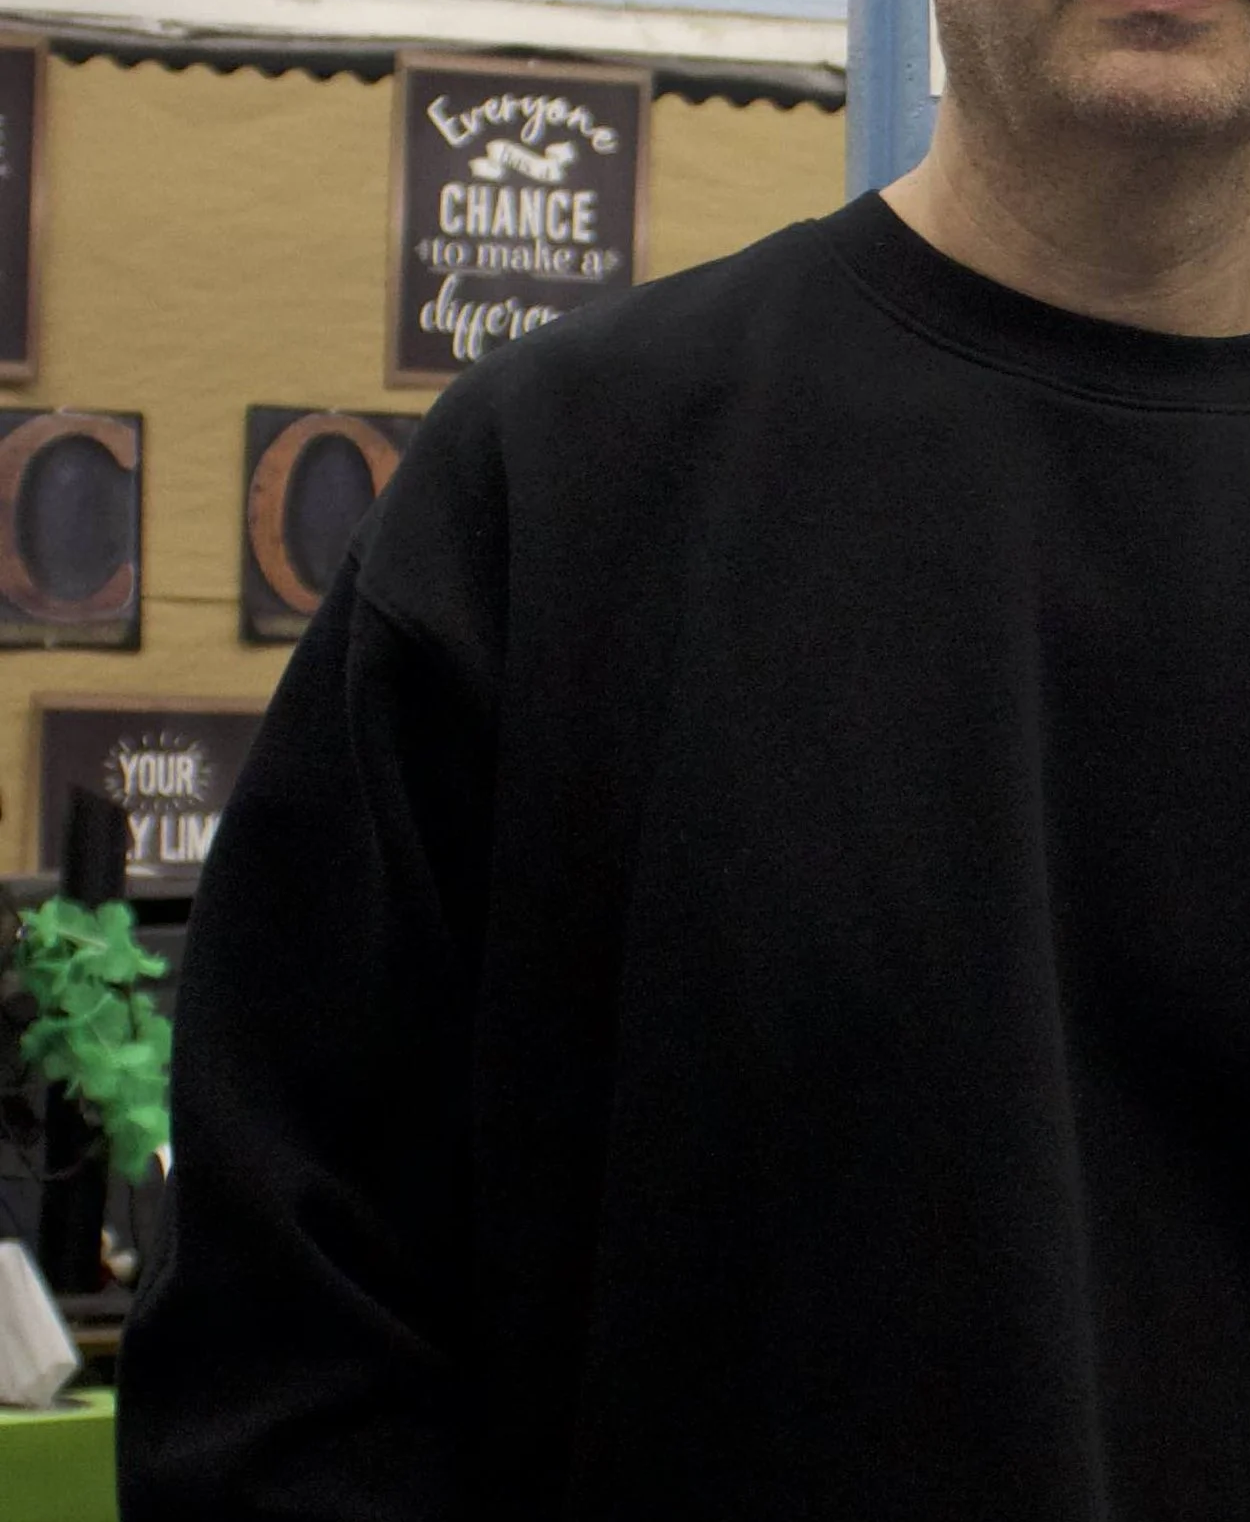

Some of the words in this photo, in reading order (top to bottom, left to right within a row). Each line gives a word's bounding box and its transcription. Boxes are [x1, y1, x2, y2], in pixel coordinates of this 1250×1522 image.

[427, 93, 620, 155] Everyone
[439, 182, 598, 243] CHANCE
[431, 239, 467, 267] to
[477, 241, 575, 274] make
[581, 249, 604, 276] a
[419, 272, 564, 362] differe
[118, 752, 196, 797] YOUR
